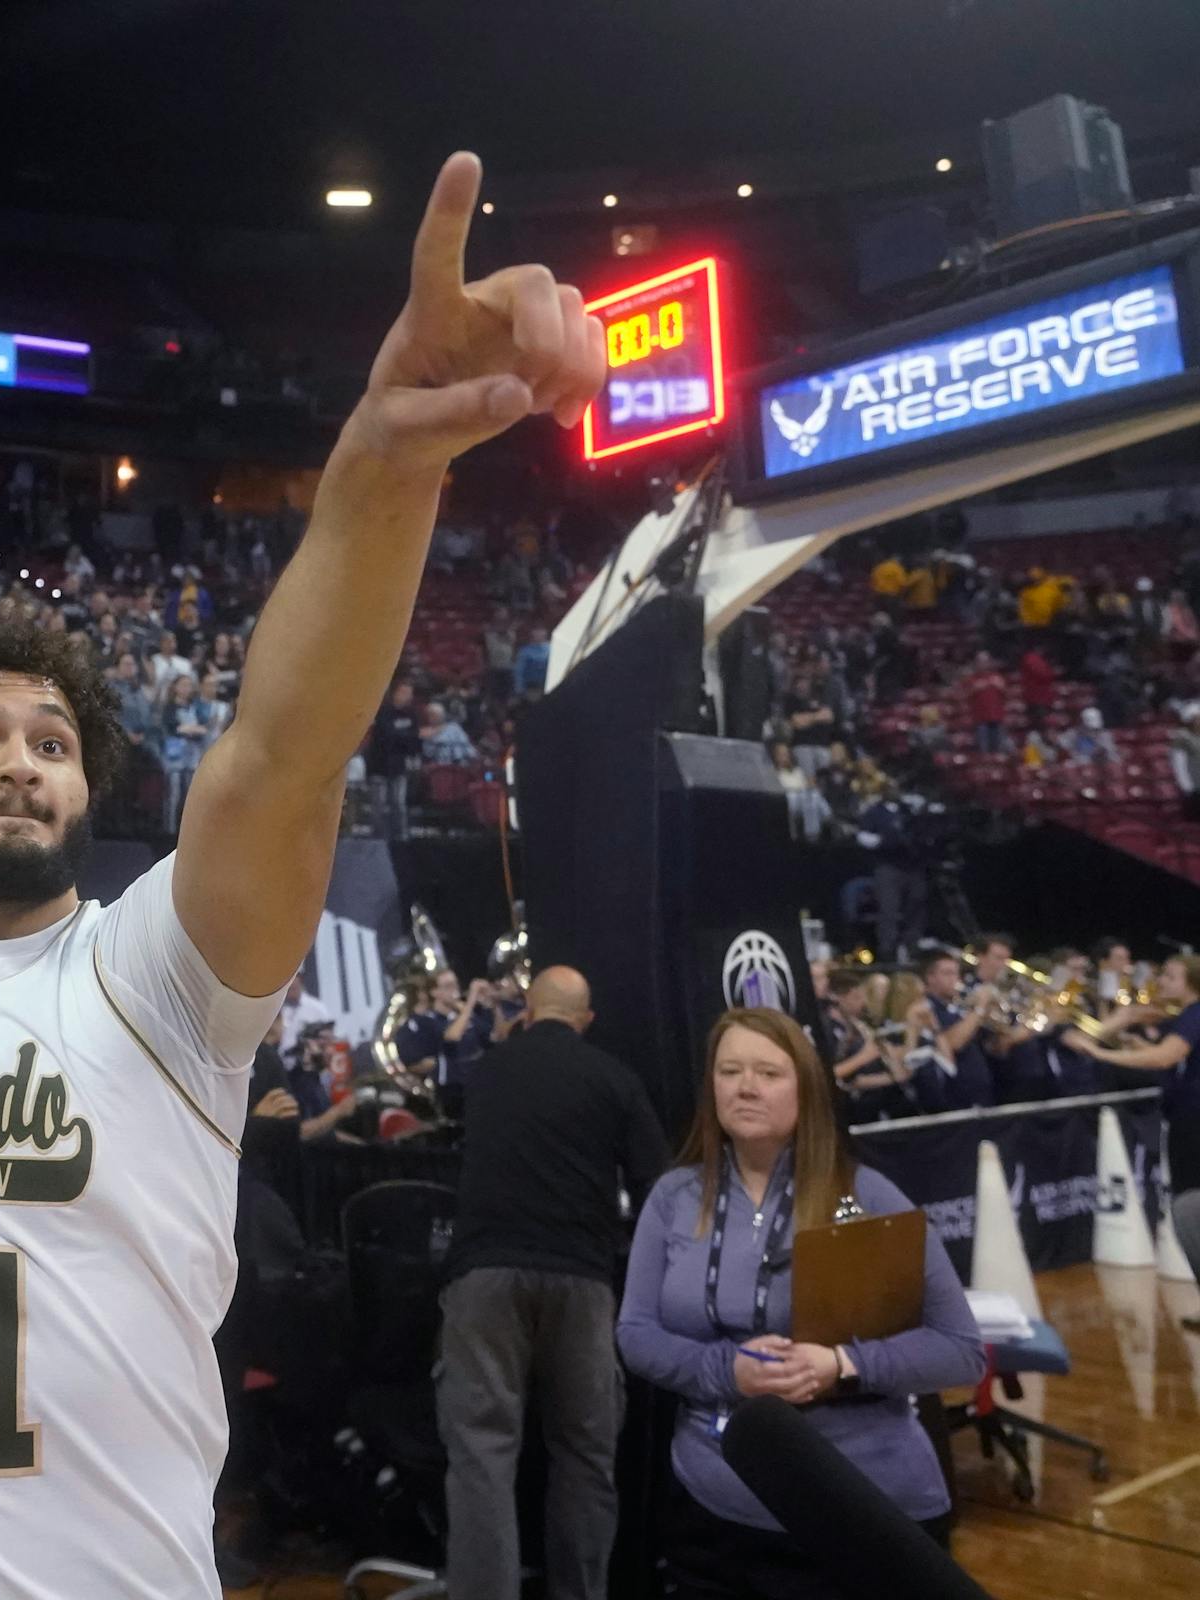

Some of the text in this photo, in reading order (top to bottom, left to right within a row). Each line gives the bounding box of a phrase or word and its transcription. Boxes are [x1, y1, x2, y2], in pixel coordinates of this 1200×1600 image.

[607, 301, 684, 369] 00.0
[842, 288, 1158, 410] AIR FORCE
[860, 334, 1141, 442] RESERVE
